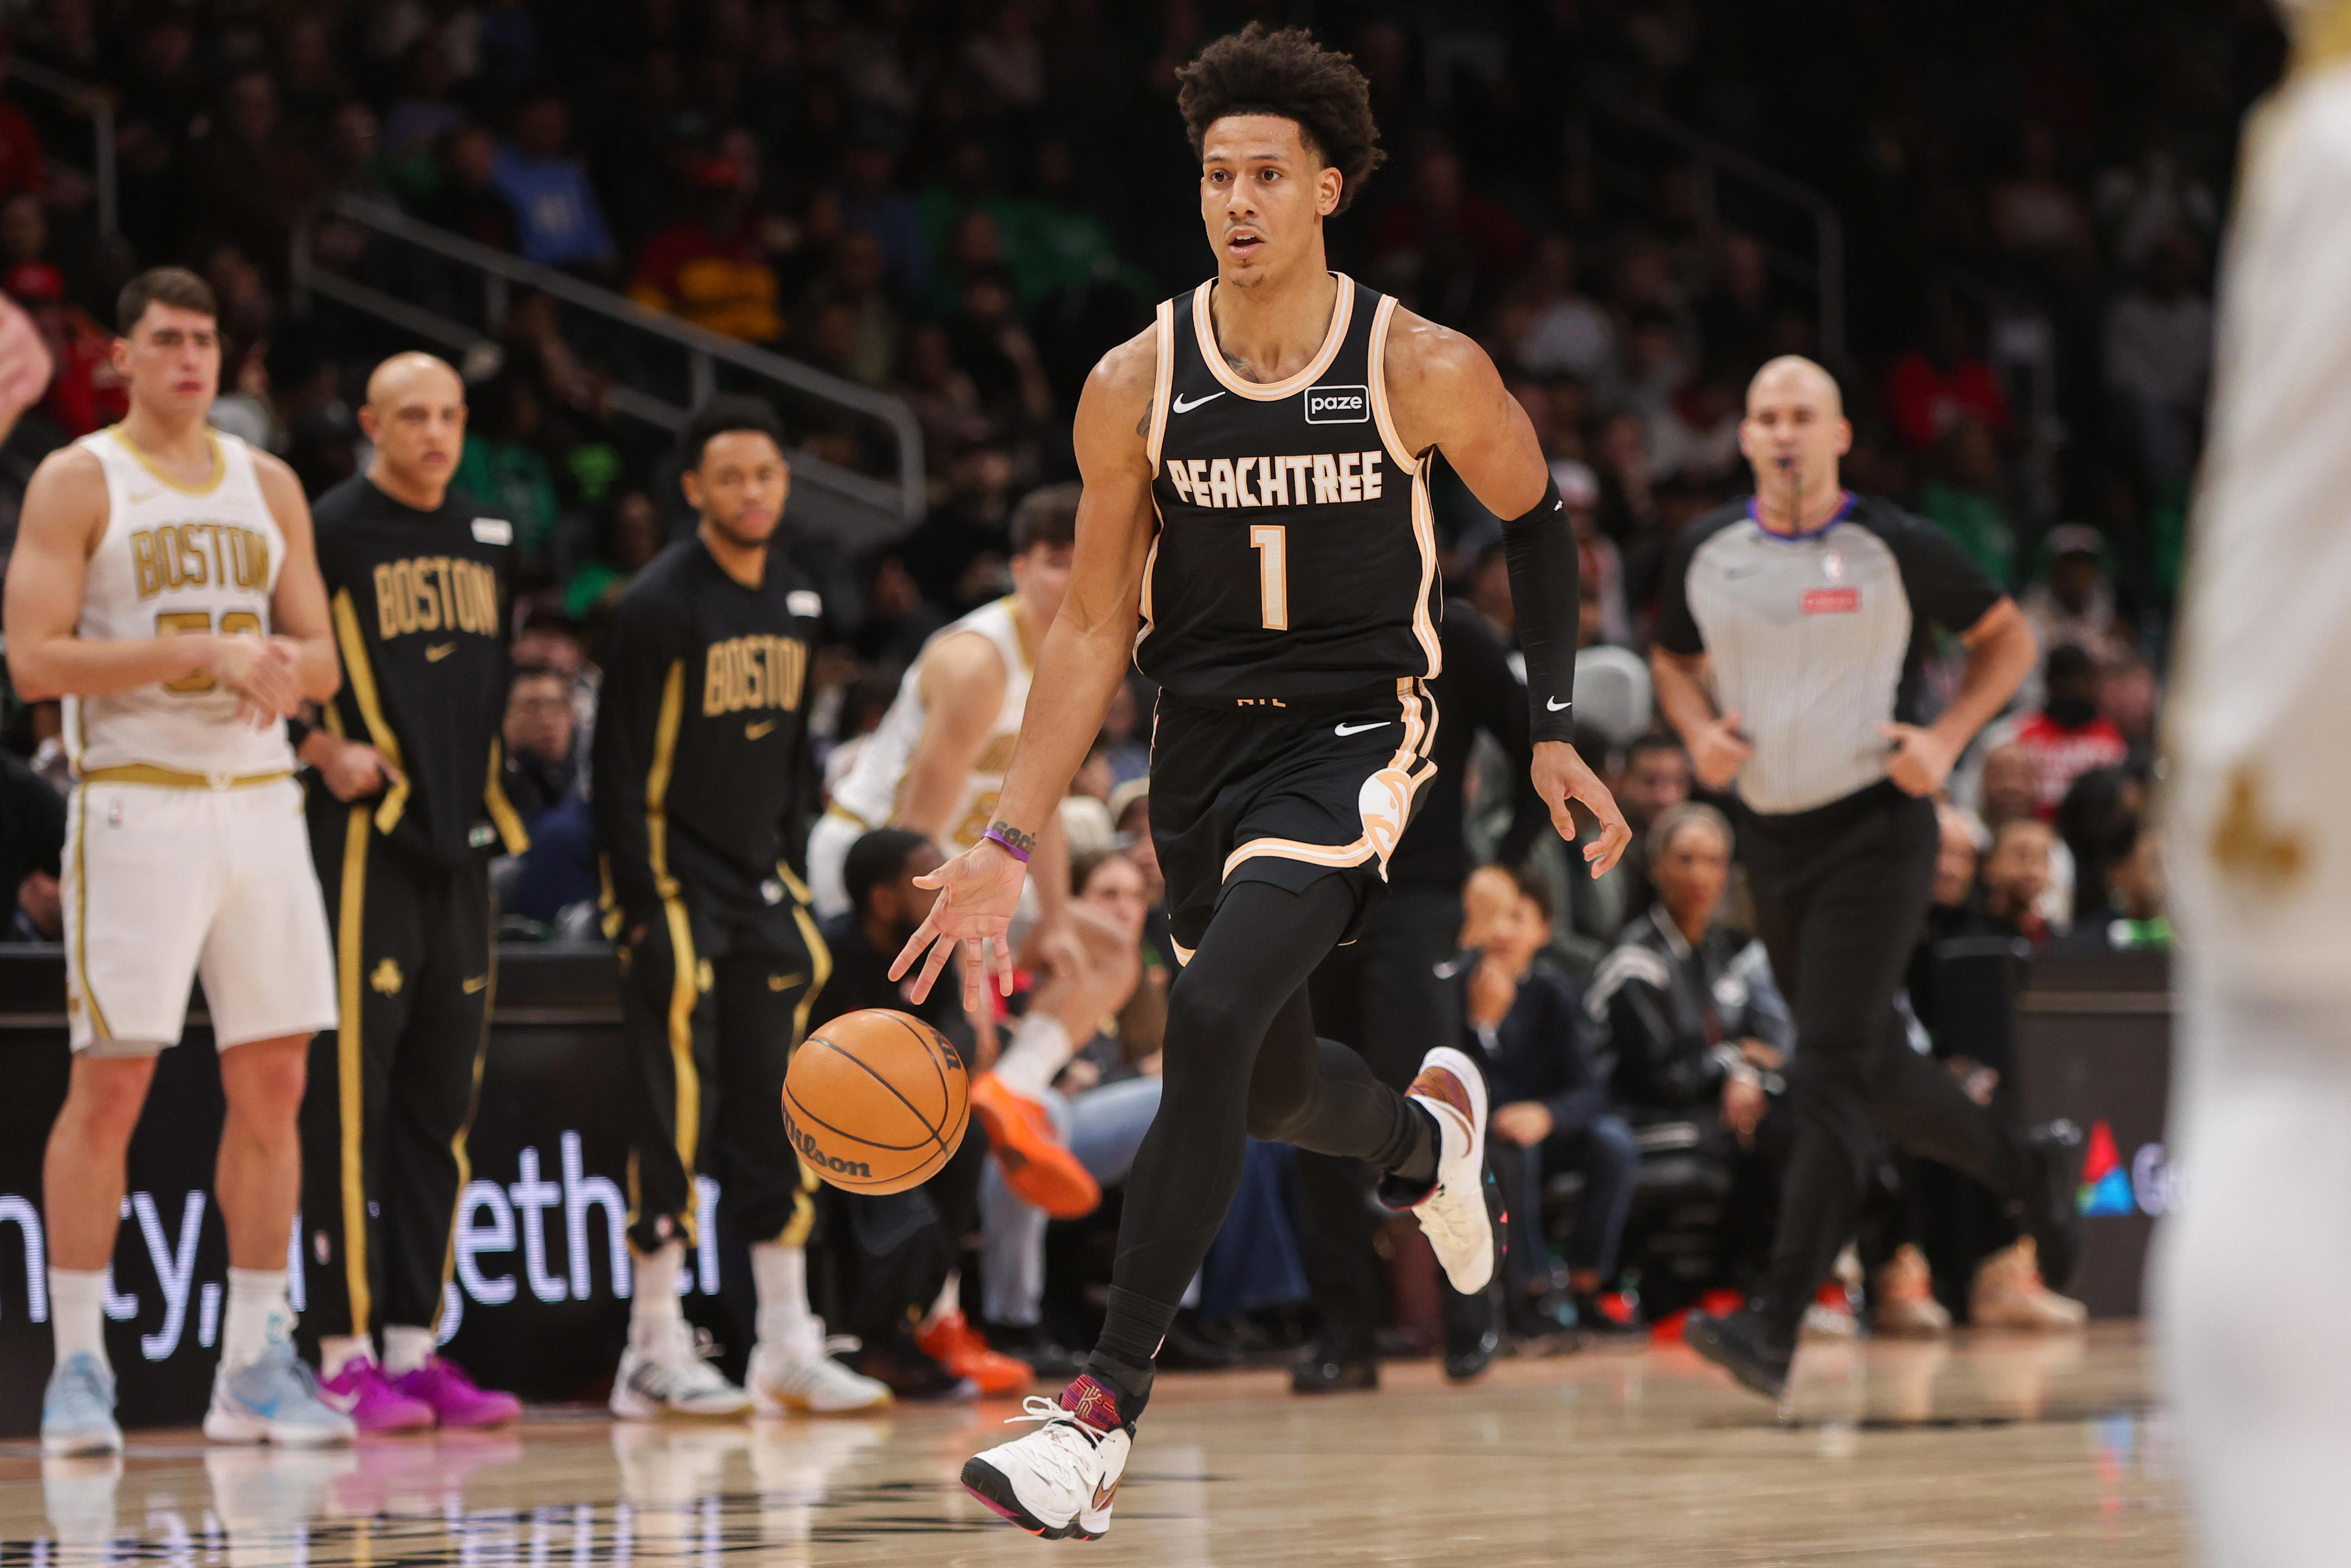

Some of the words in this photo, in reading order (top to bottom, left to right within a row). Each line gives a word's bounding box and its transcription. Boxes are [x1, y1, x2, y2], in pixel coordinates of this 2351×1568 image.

[1311, 396, 1363, 414] paze
[1166, 450, 1382, 508] PEACHTREE
[130, 524, 269, 598] BOSTON
[1250, 525, 1288, 631] 1
[373, 556, 499, 641] BOSTON
